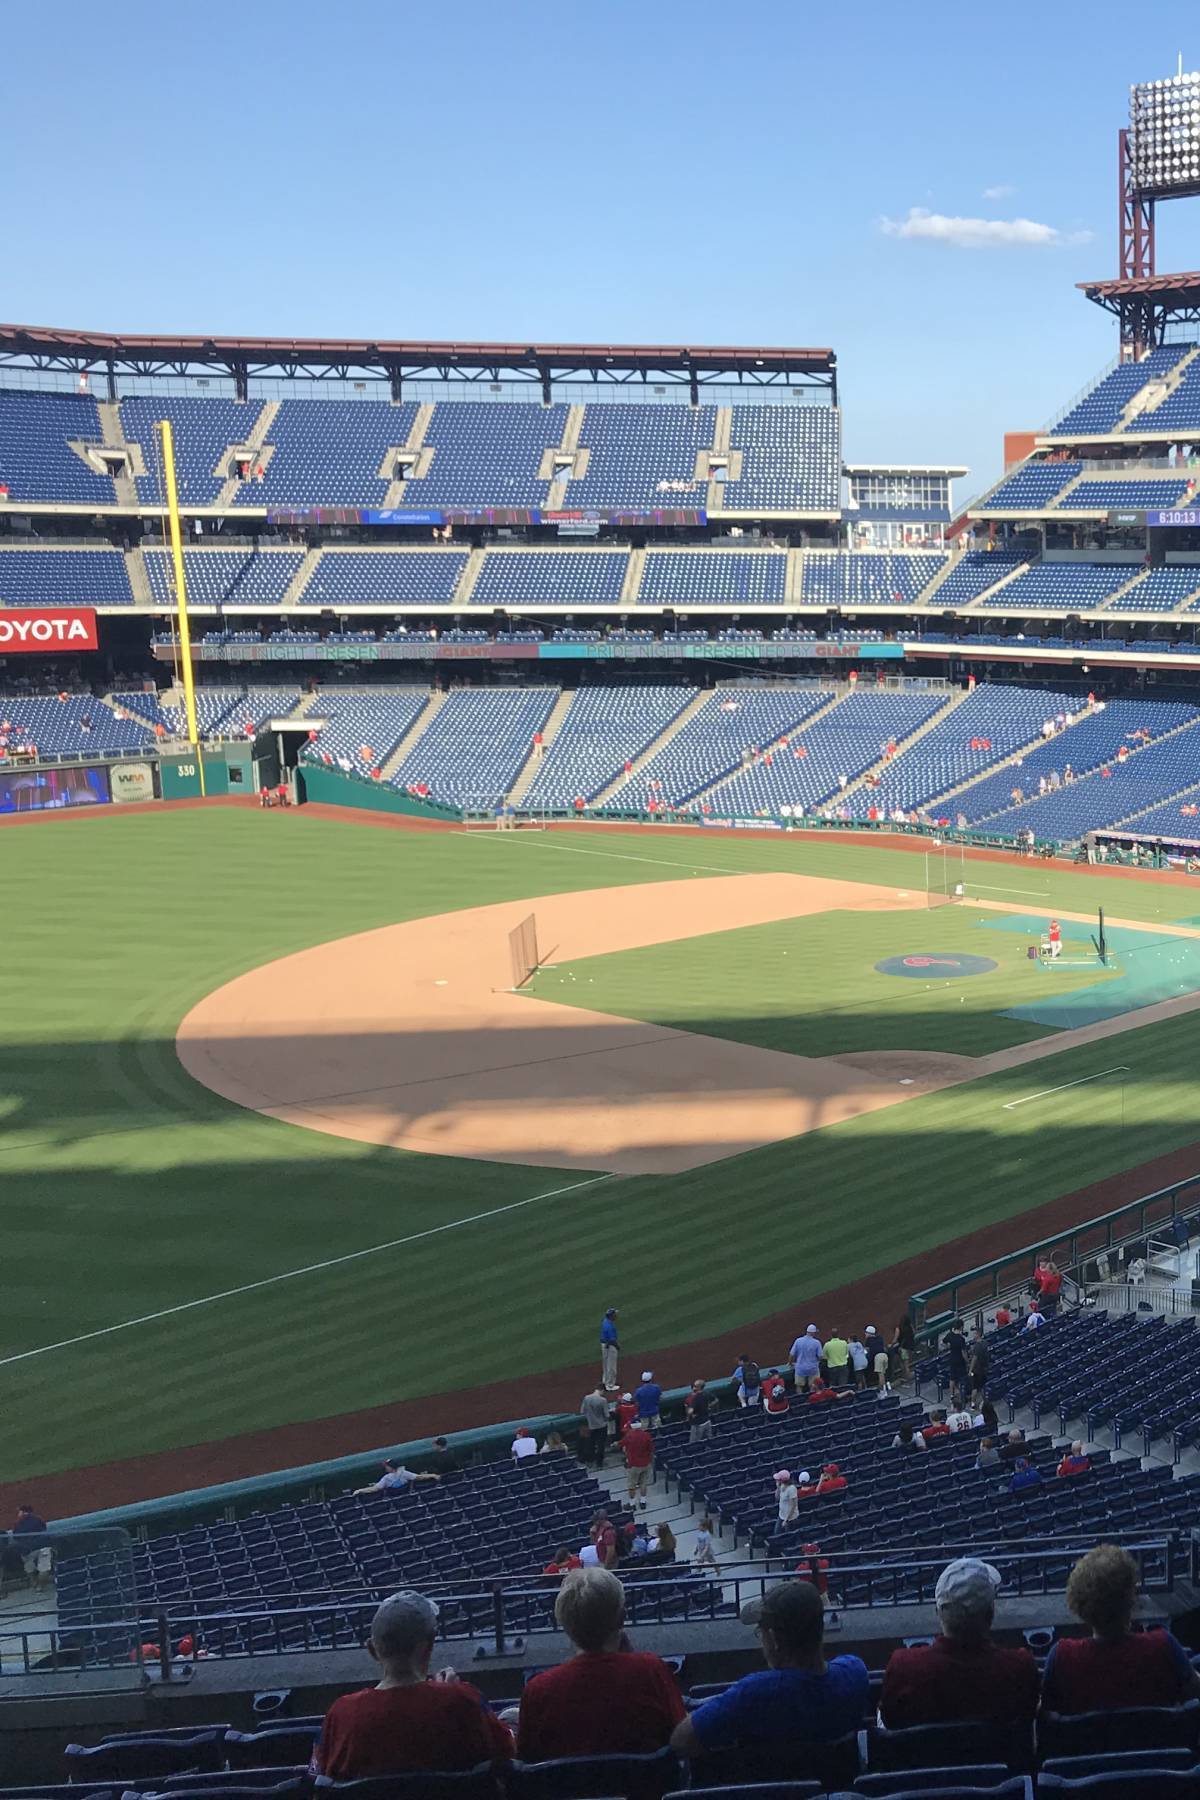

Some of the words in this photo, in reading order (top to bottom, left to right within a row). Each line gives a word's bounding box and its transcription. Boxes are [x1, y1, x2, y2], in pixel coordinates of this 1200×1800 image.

[1159, 511, 1196, 524] 6:10:13
[0, 618, 89, 642] OYOTA
[587, 645, 629, 659] PRIDE
[639, 645, 684, 659] NIGHT
[692, 645, 785, 659] PRESENTED
[791, 645, 811, 658] BY
[815, 644, 861, 658] GIANT
[178, 764, 195, 777] 330
